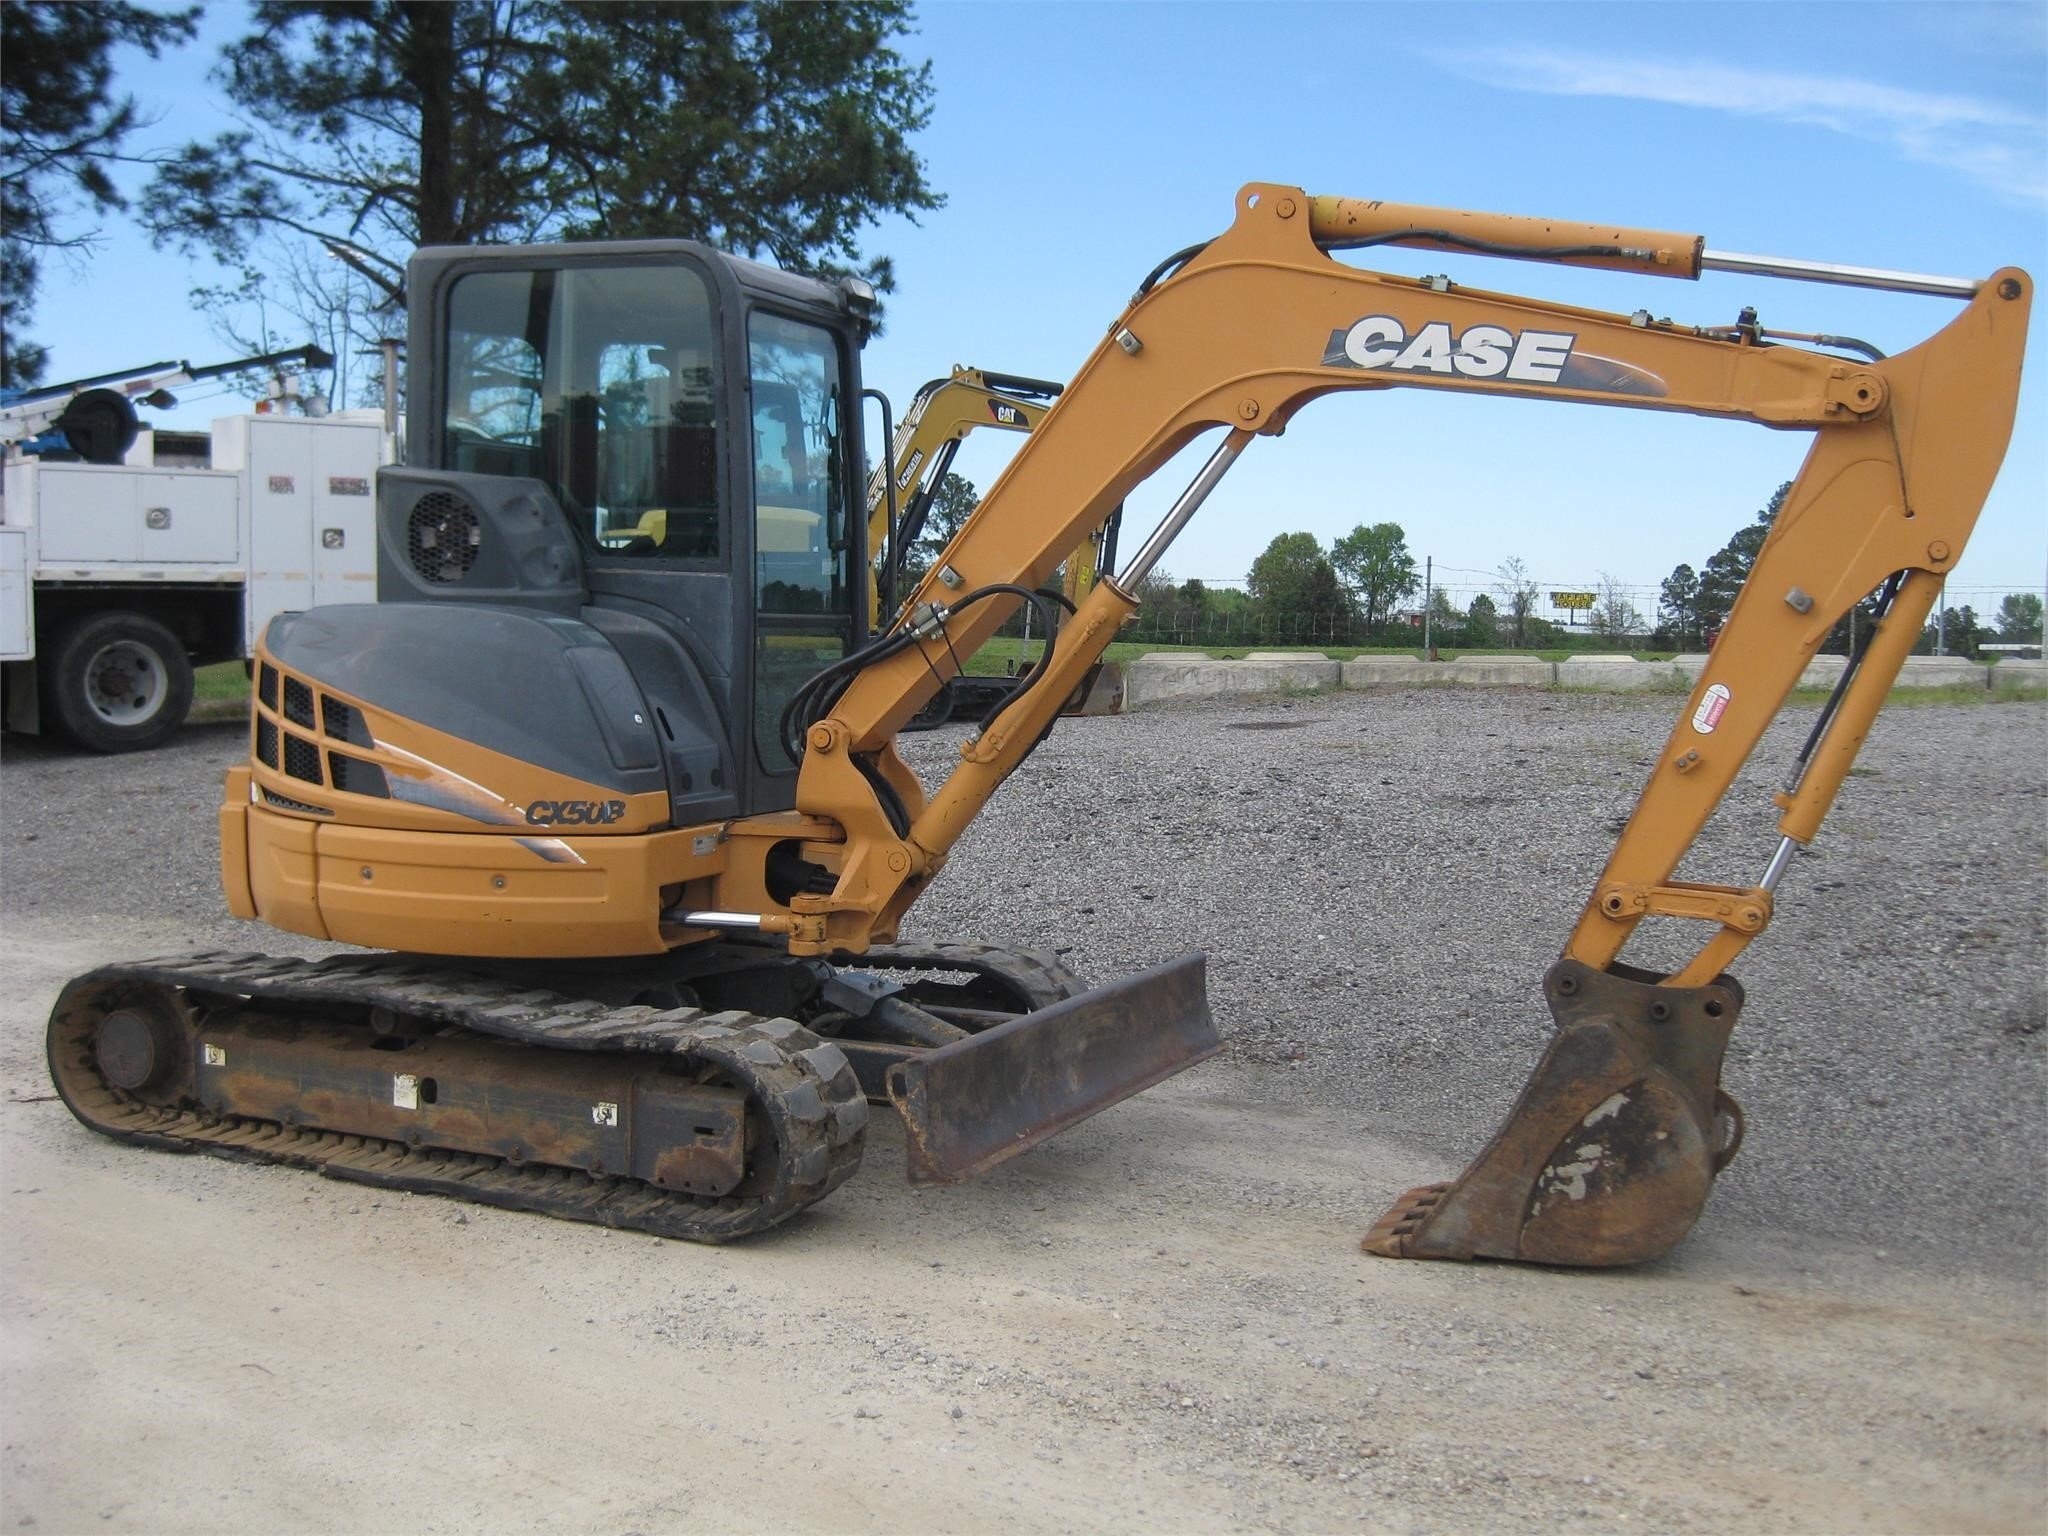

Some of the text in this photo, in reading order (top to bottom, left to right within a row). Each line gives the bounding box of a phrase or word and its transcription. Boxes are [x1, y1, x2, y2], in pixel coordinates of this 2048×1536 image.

[1344, 315, 1573, 383] CASE
[998, 406, 1016, 423] CAT
[1551, 592, 1596, 602] WAFFLE
